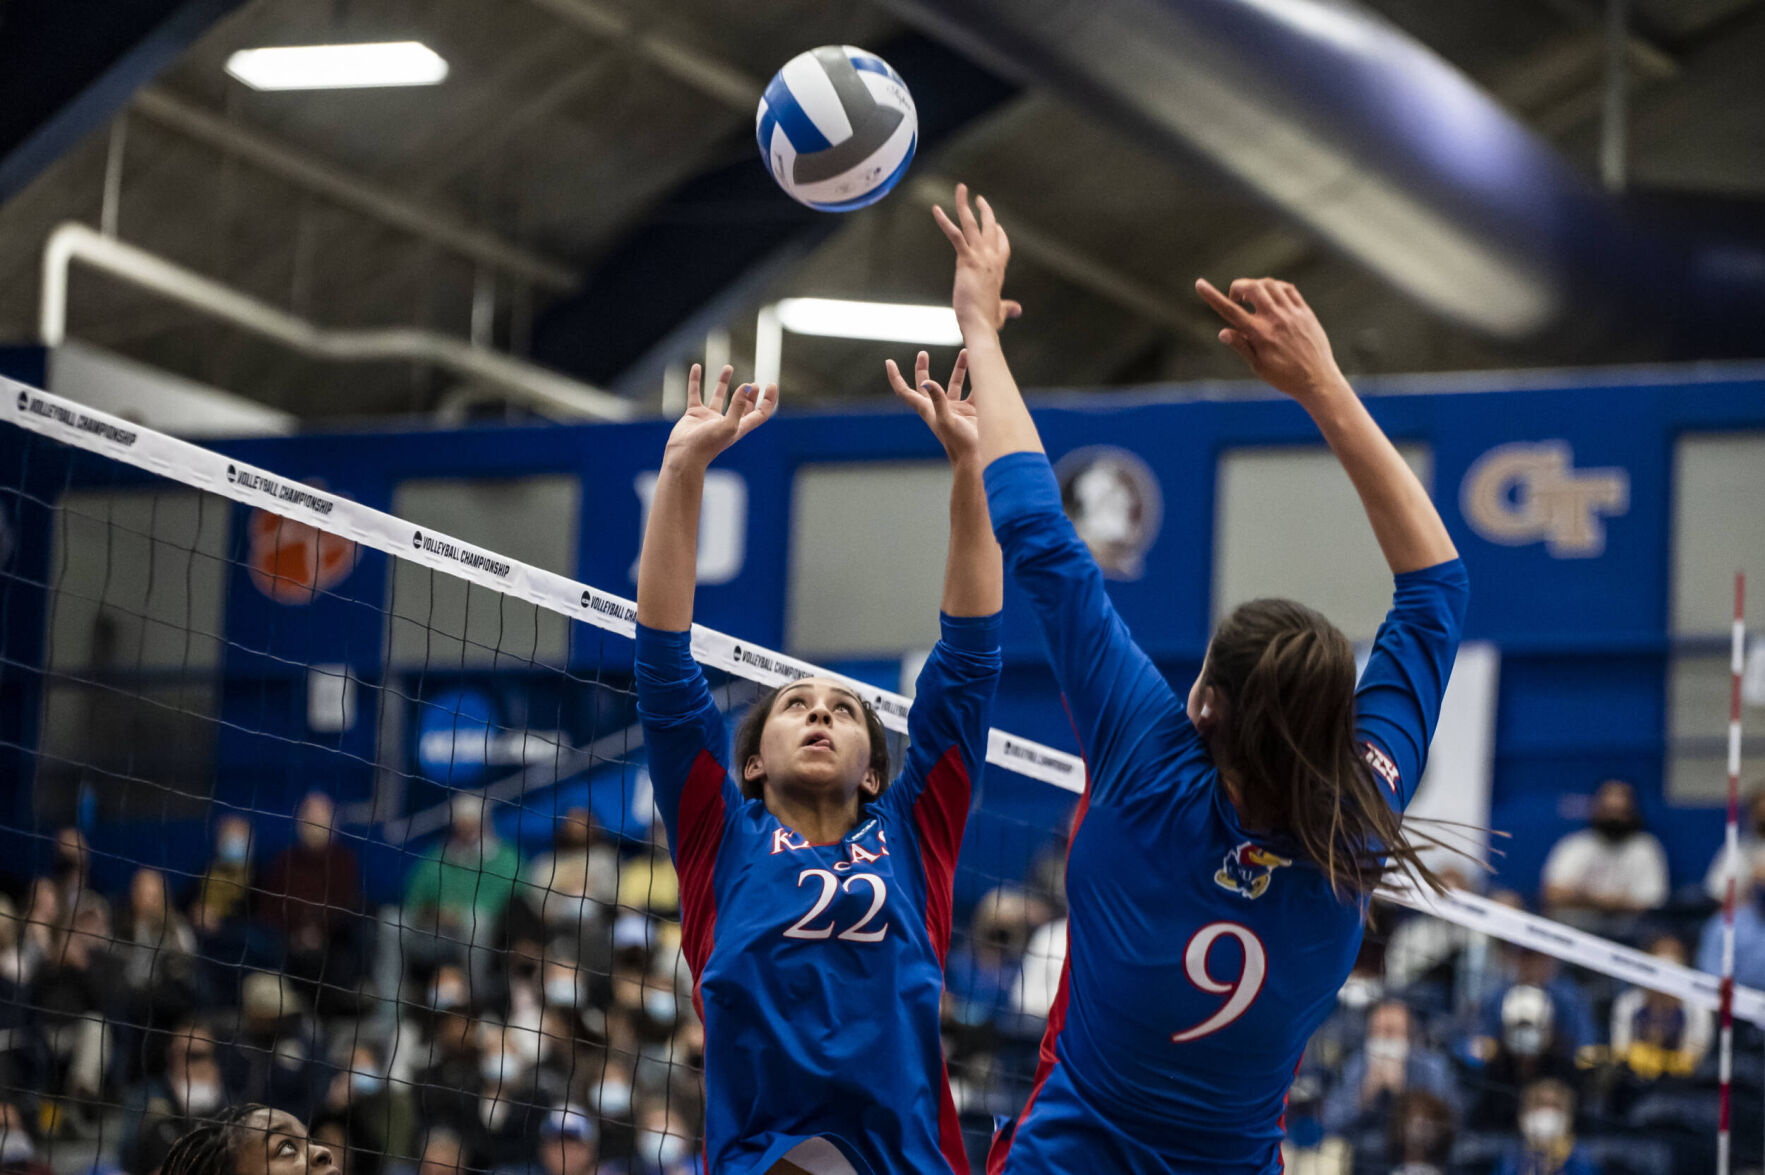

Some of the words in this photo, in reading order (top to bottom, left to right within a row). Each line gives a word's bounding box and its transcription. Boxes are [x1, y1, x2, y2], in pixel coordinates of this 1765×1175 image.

[30, 398, 77, 427] VOLLEYBALL
[77, 415, 137, 447] CHAMPIONSHIP
[236, 470, 279, 497] VOLLEYBALL
[279, 485, 334, 515] CHAMPIONSHIP
[423, 536, 460, 561] VOLLEYBALL
[460, 550, 511, 577] CHAMPIONSHIP
[591, 595, 625, 619] VOLLEYBALL
[742, 650, 774, 671] VOLLEYBALL
[782, 868, 889, 942] 22
[1170, 920, 1269, 1043] 9
